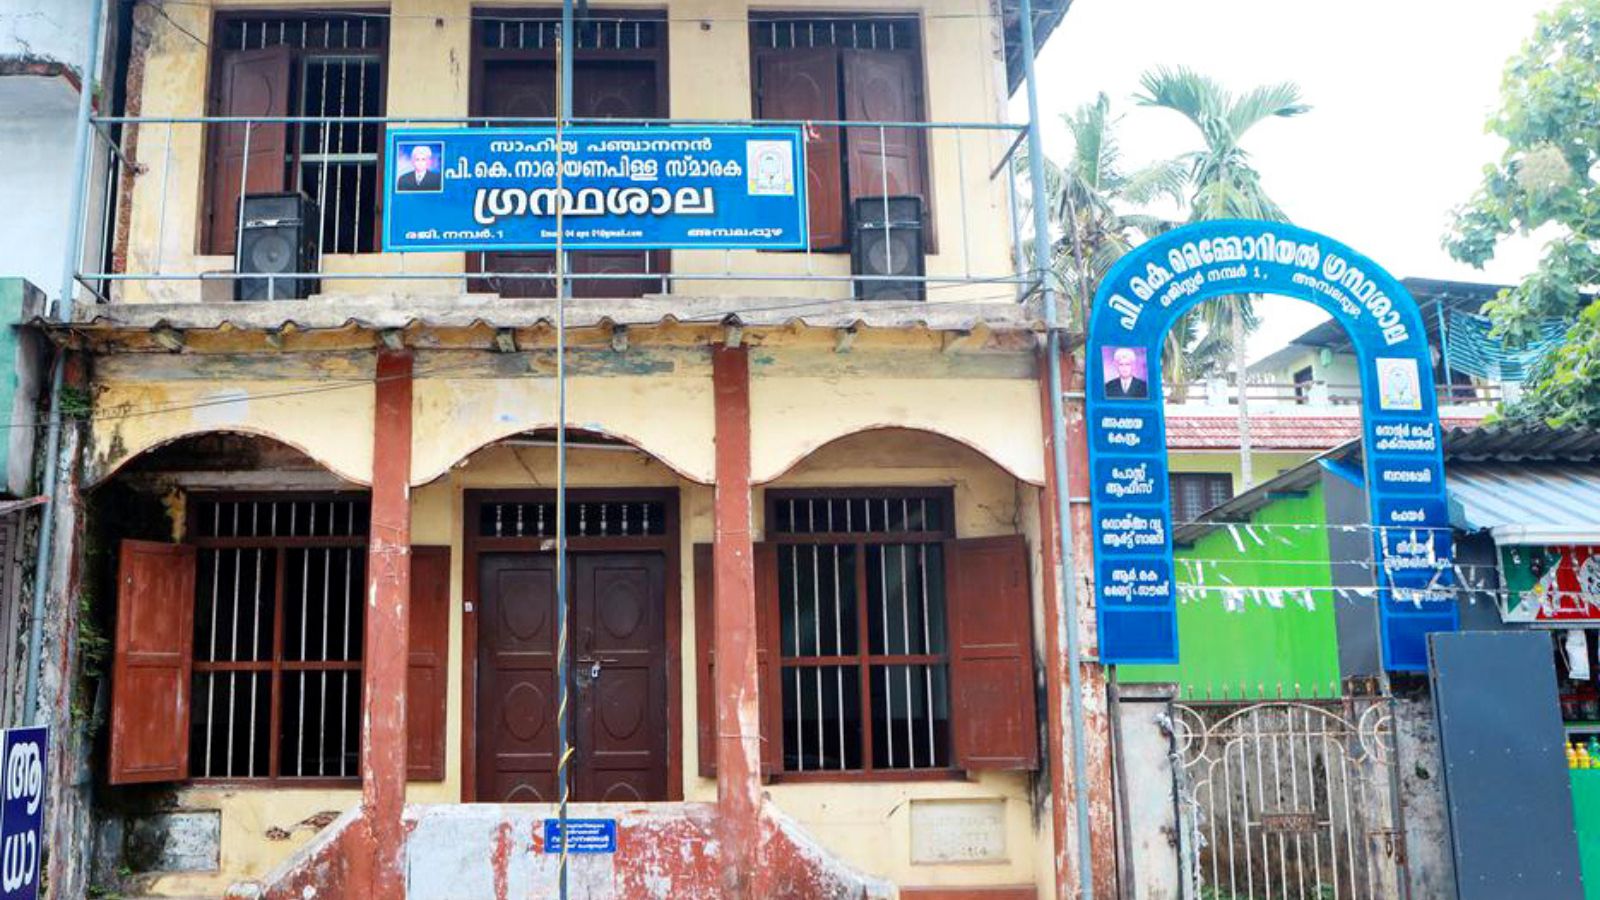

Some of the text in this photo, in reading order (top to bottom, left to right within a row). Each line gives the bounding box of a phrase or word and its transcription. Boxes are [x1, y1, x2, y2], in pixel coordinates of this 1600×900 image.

[490, 138, 578, 155] സാഹിത്യ
[665, 155, 742, 177] സ്മാരക
[474, 186, 714, 224] ഗ്രന്ഥശാല
[1323, 252, 1409, 346] ഗ്രന്ഥശാല
